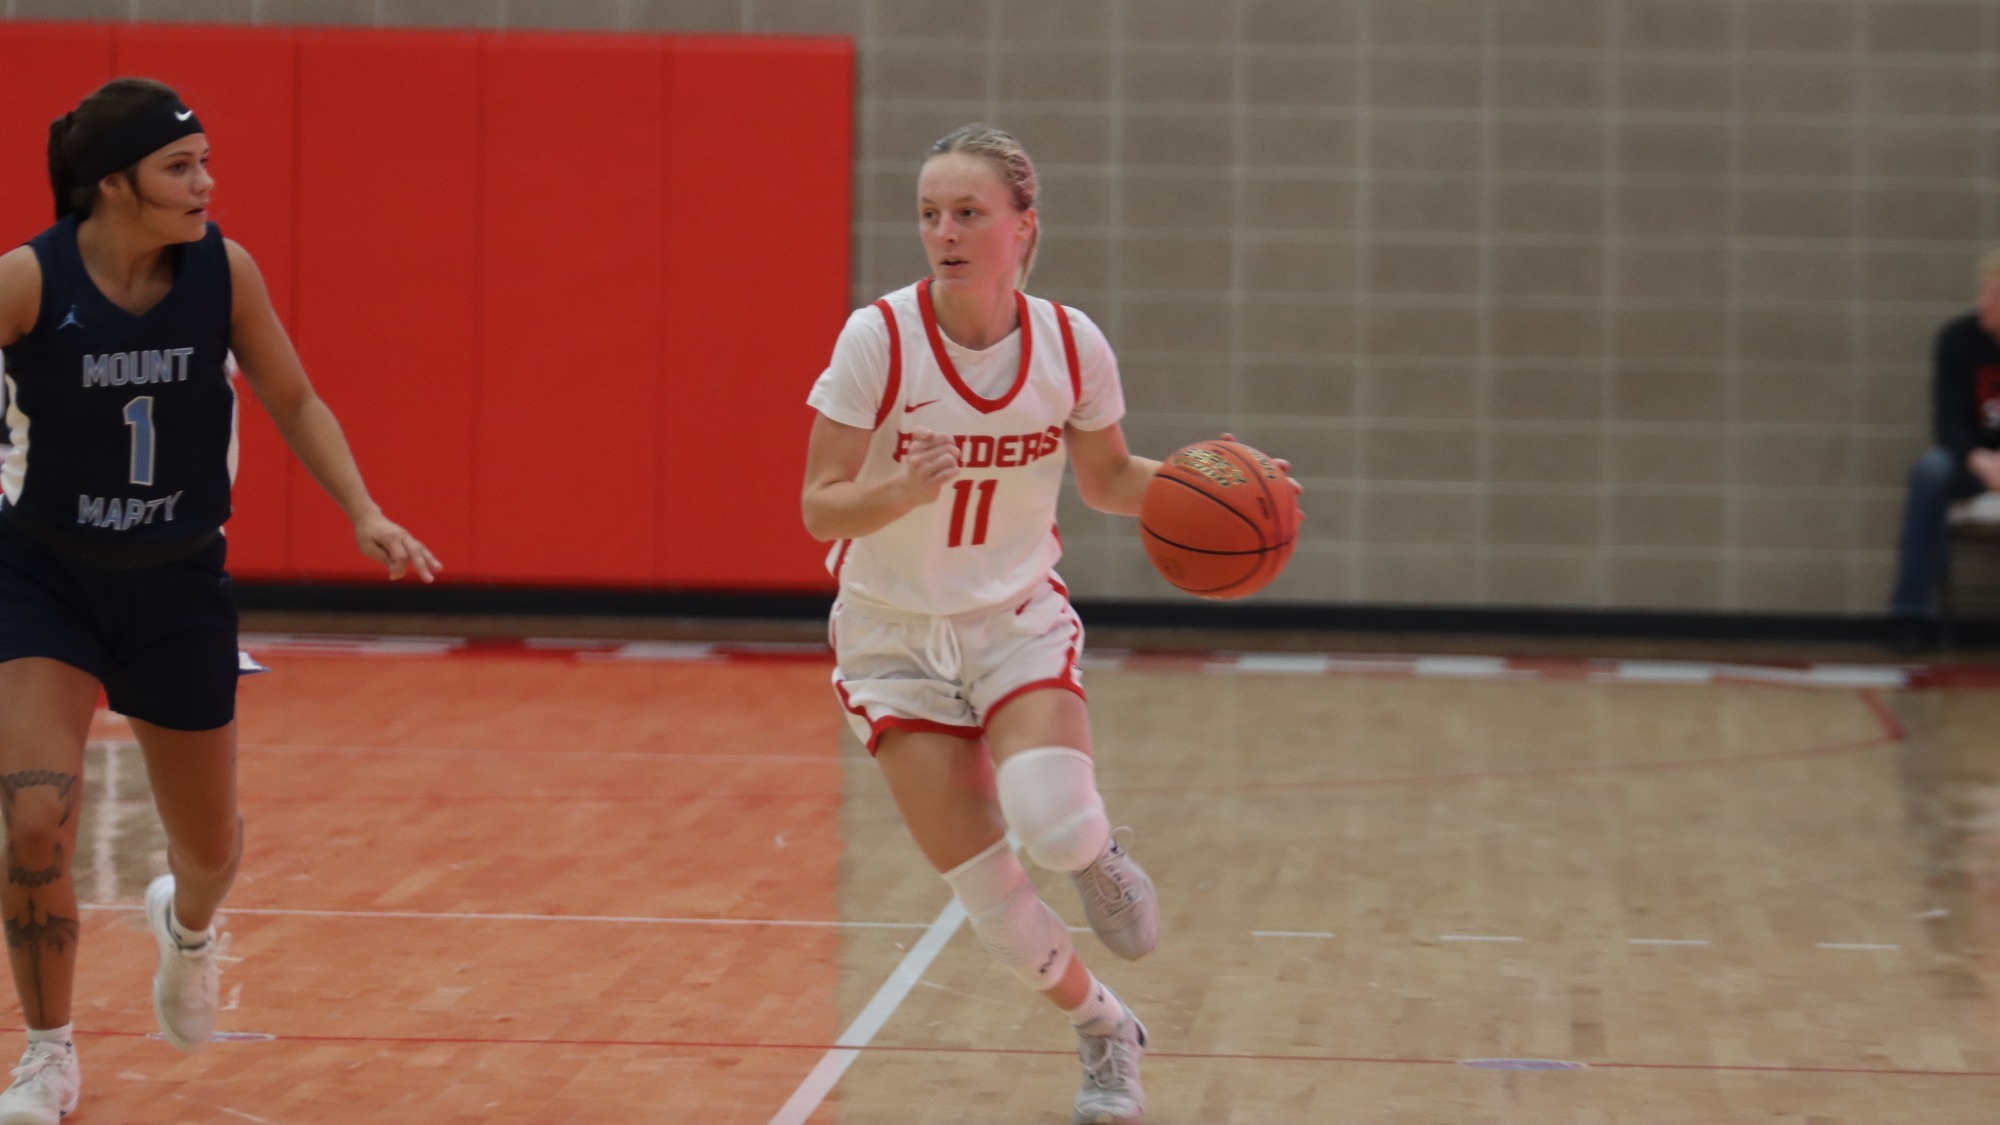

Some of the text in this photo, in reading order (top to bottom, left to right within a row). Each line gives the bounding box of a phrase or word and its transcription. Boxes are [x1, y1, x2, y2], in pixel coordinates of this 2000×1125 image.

[82, 347, 194, 387] MOUNT
[123, 395, 155, 486] 1
[892, 425, 1062, 468] RIDERS
[77, 490, 183, 530] MARTY
[947, 479, 997, 548] 11
